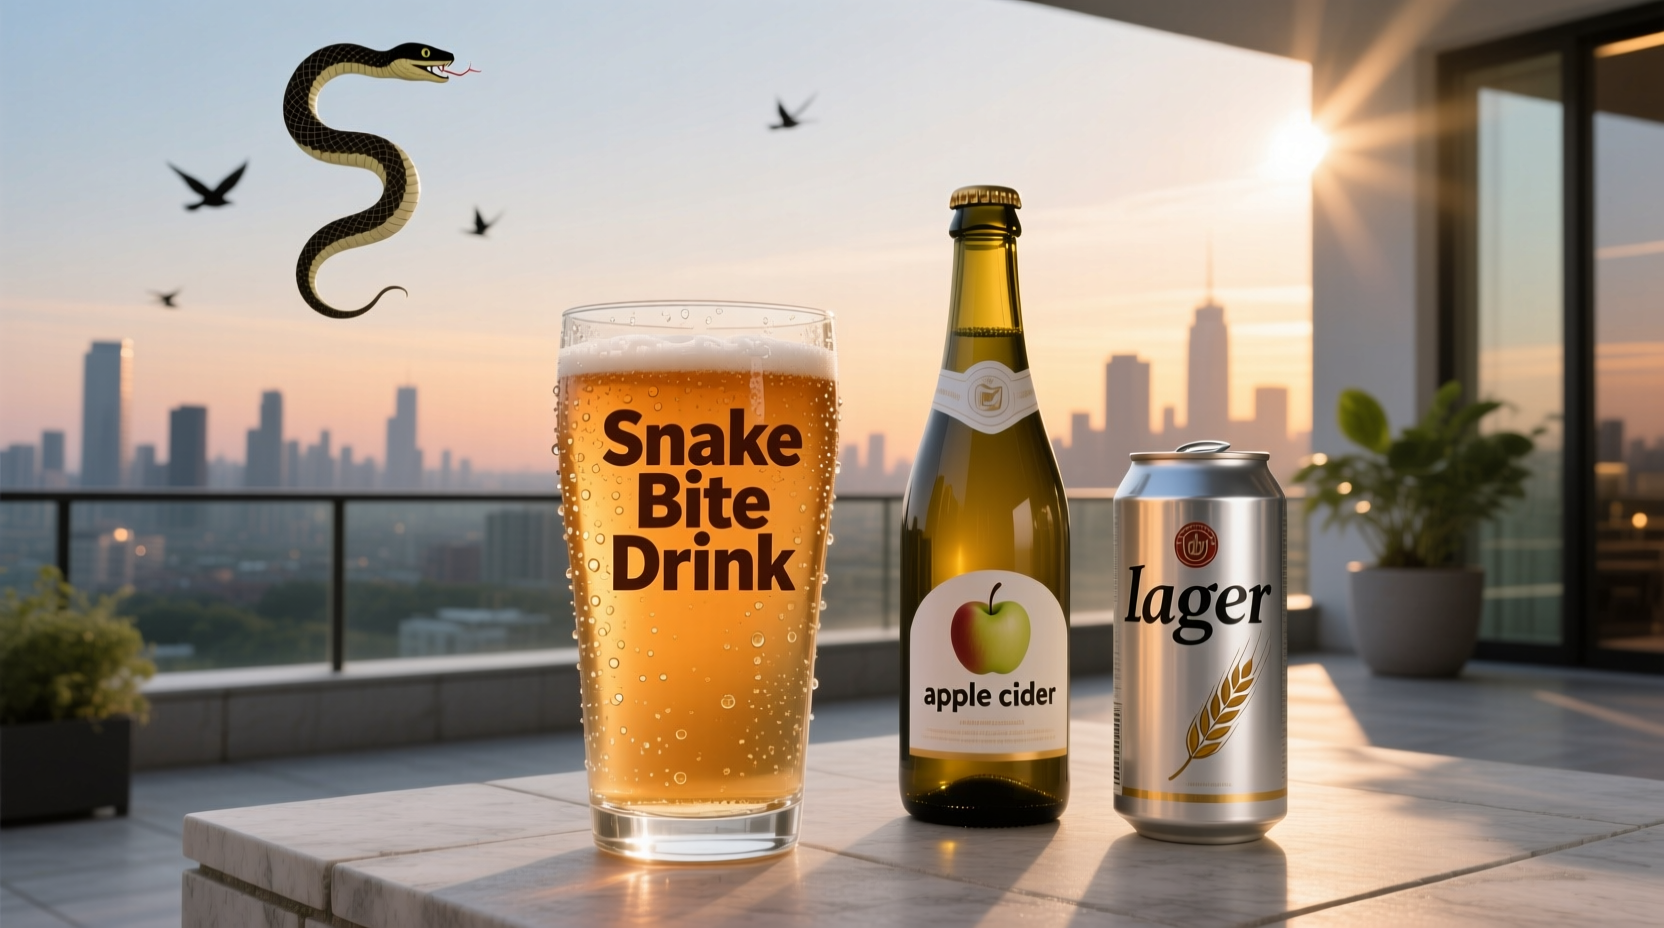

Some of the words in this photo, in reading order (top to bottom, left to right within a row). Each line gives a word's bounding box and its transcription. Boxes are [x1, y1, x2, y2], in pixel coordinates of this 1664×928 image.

[603, 408, 802, 466] Snake
[639, 468, 770, 529] Bite
[612, 531, 796, 591] Drink
[1124, 564, 1272, 646] lager
[924, 681, 992, 713] apple
[998, 680, 1057, 707] cider
